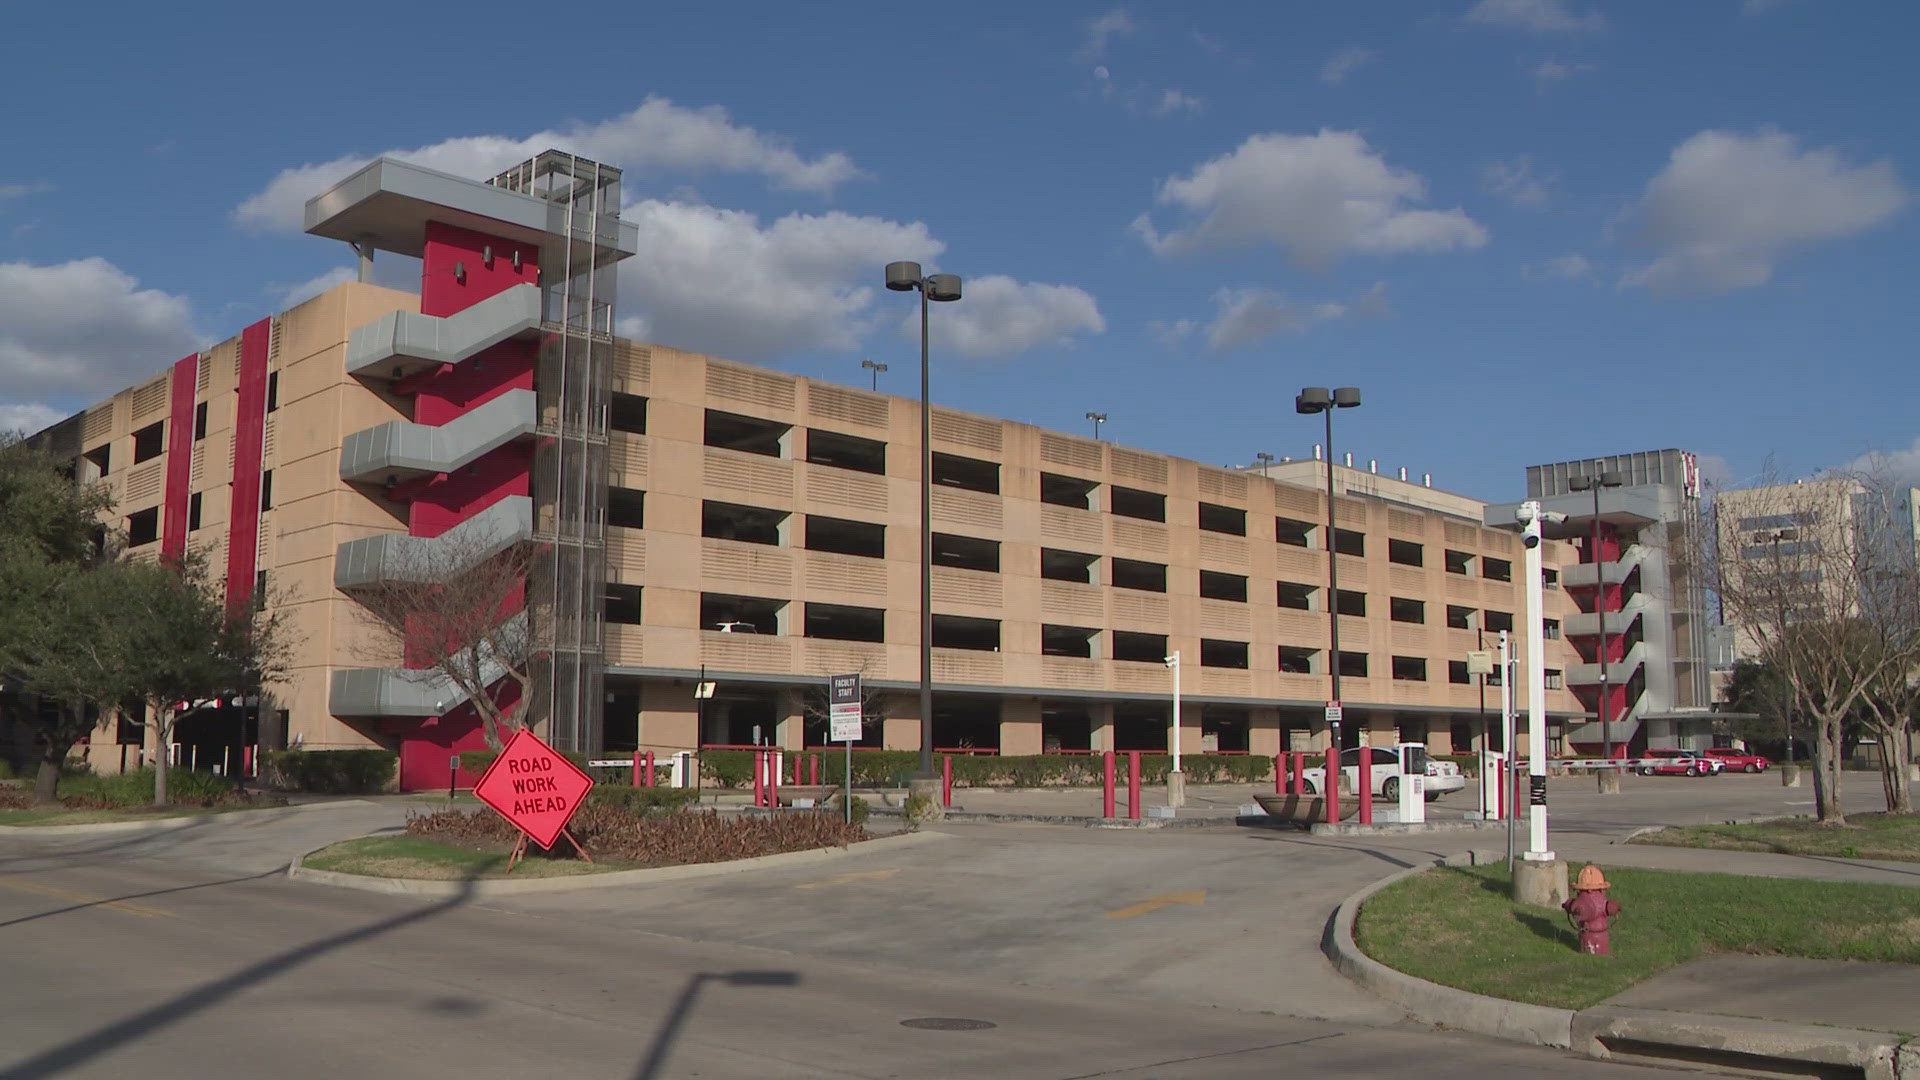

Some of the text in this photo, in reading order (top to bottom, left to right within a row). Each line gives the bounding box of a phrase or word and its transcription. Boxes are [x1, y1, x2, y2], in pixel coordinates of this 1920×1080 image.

[834, 678, 855, 688] FACULTY
[838, 688, 853, 697] STAFF
[508, 757, 552, 774] ROAD
[512, 776, 558, 794] WORK
[513, 796, 567, 815] AHEAD
